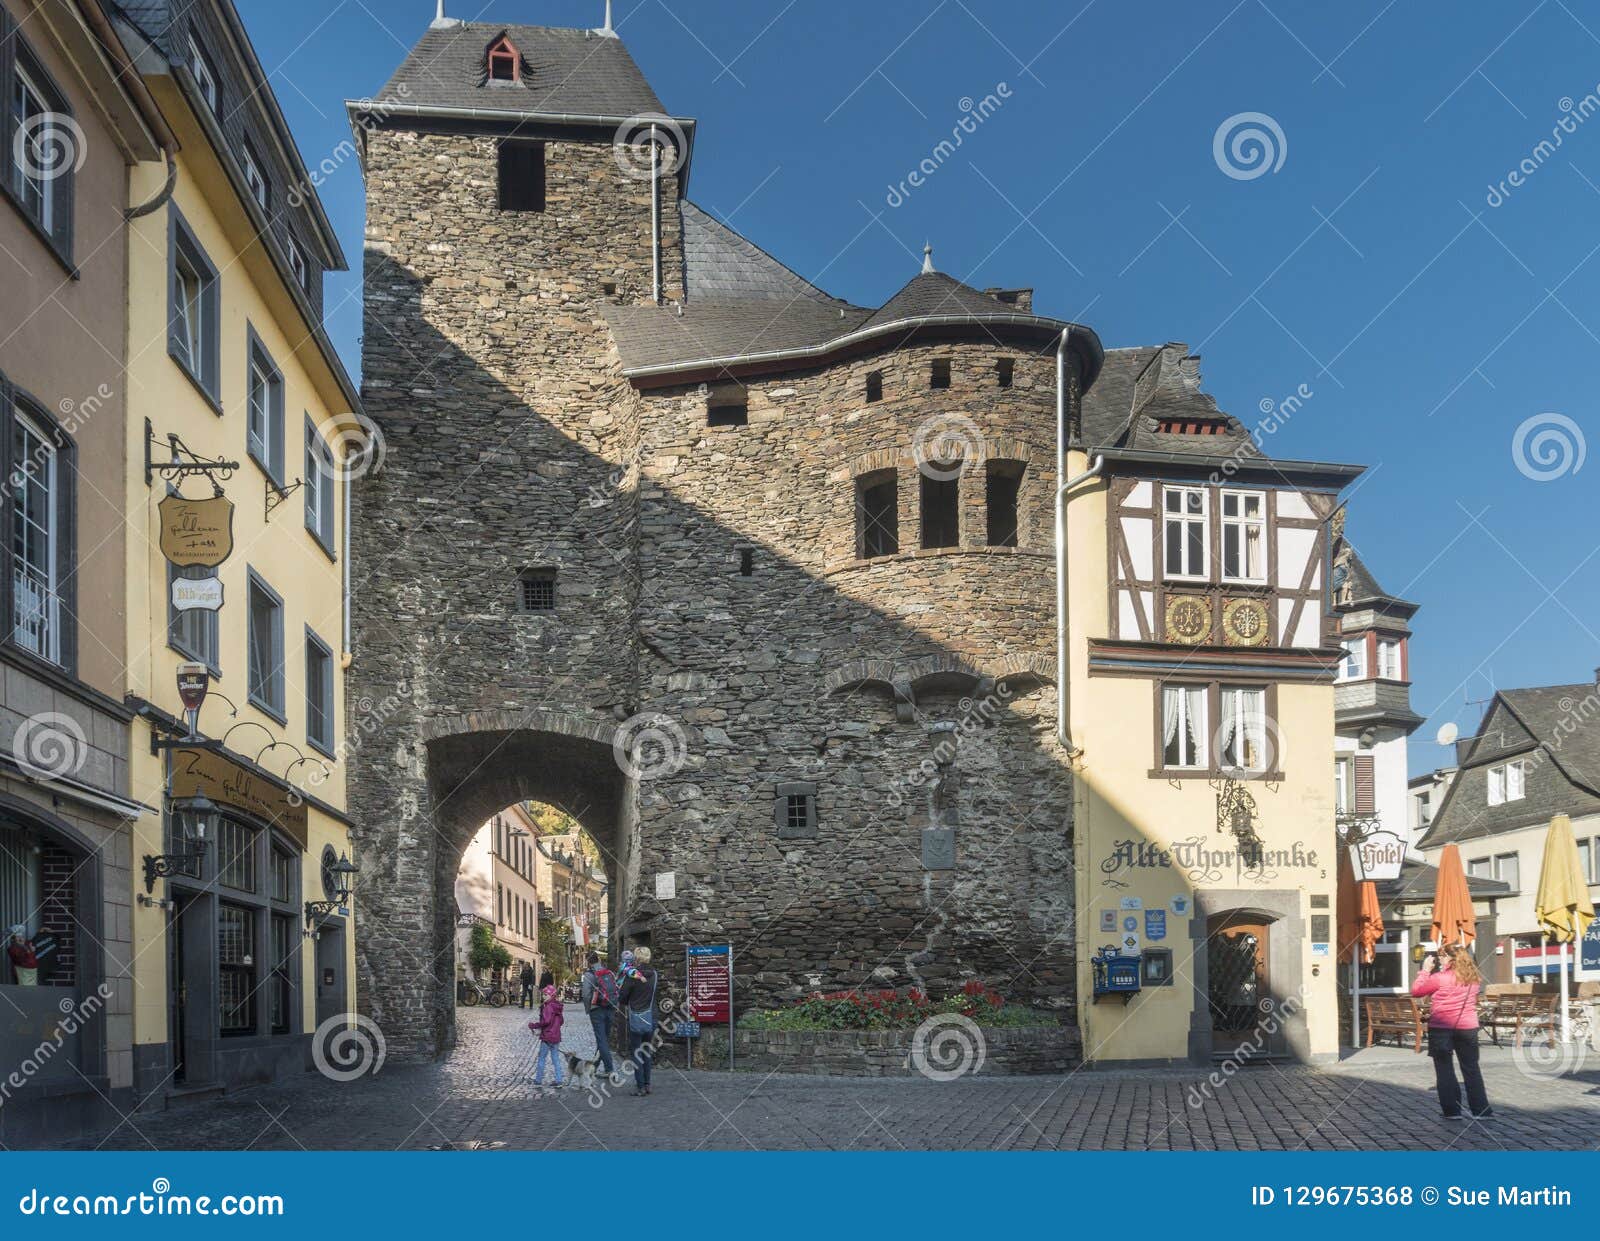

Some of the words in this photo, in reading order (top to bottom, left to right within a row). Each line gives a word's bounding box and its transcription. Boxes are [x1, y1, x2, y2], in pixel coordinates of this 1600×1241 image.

[1101, 837, 1173, 887] Alte
[1362, 842, 1404, 872] Hotel
[1320, 869, 1327, 879] 3
